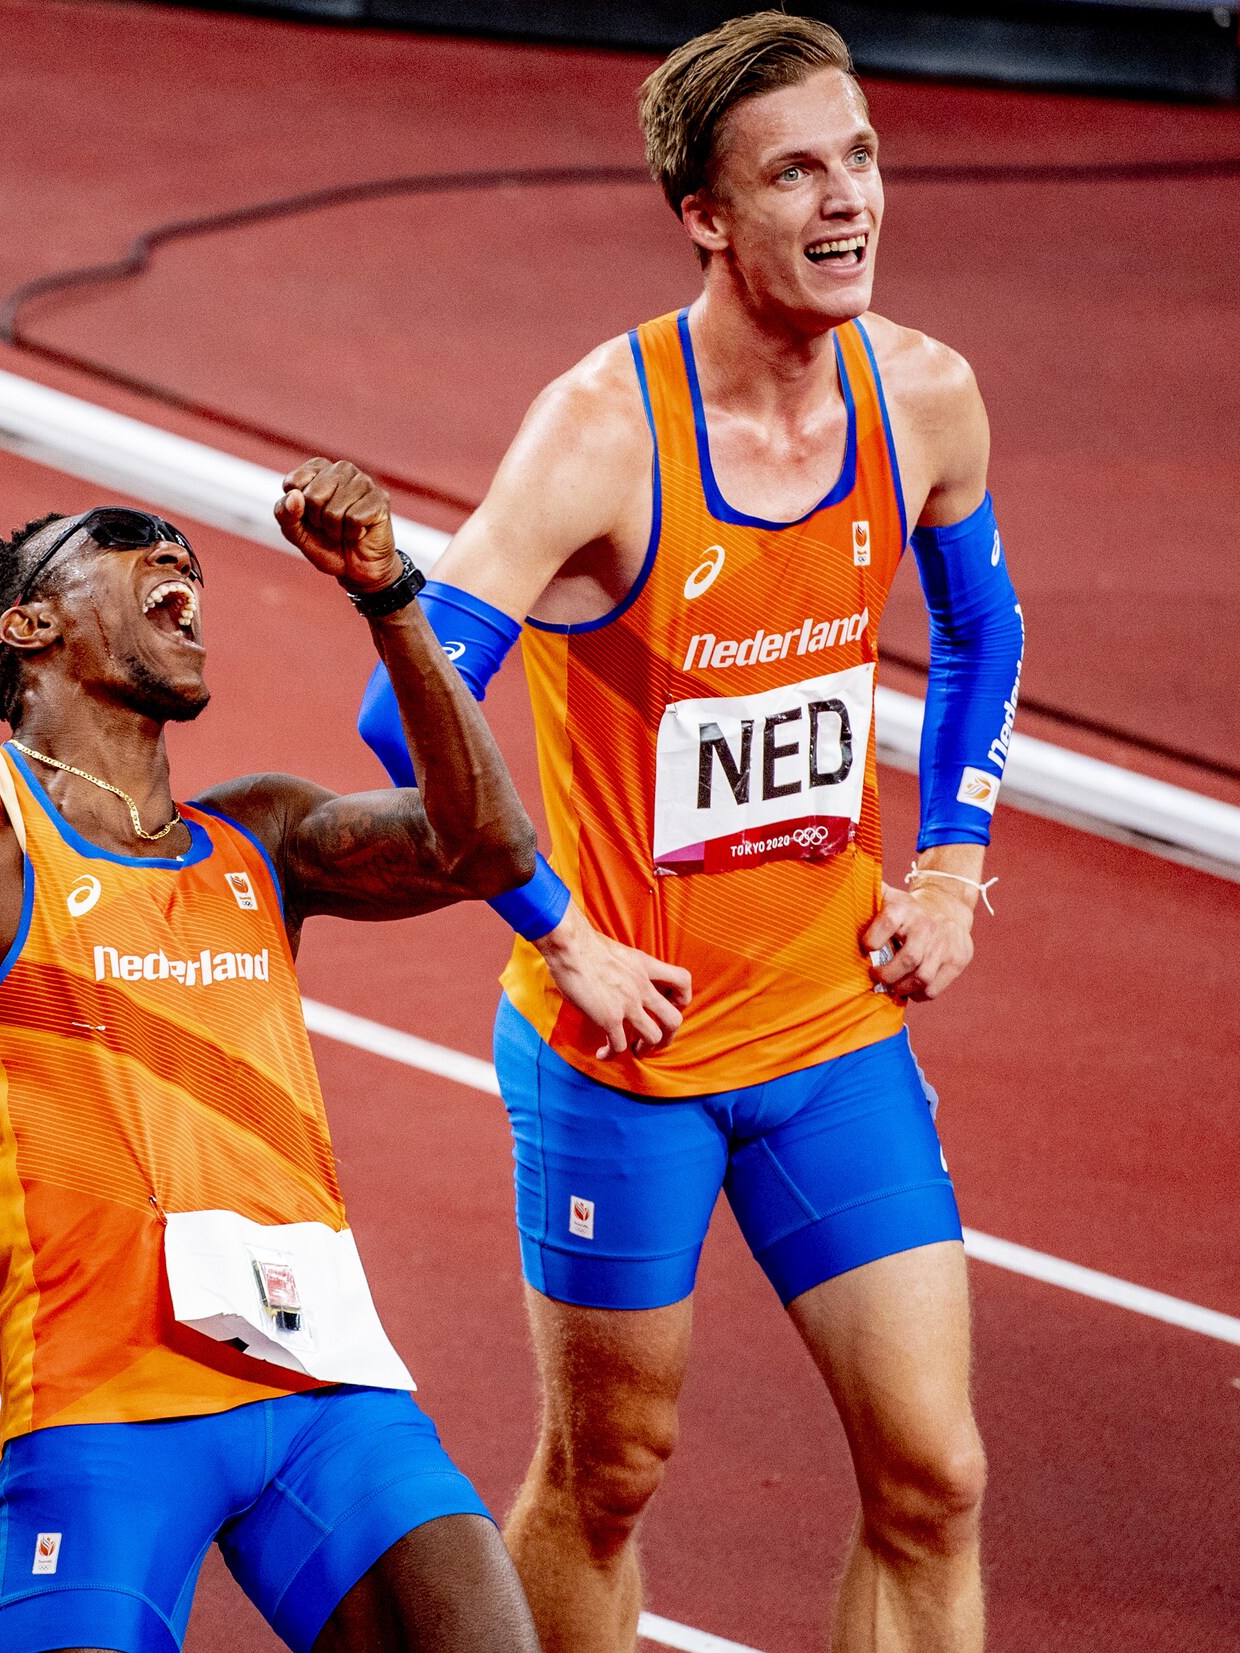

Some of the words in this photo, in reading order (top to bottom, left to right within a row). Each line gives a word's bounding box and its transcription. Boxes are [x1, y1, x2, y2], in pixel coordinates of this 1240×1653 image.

[696, 698, 854, 809] NED
[730, 840, 765, 857] TOKYO
[766, 834, 790, 851] 2020
